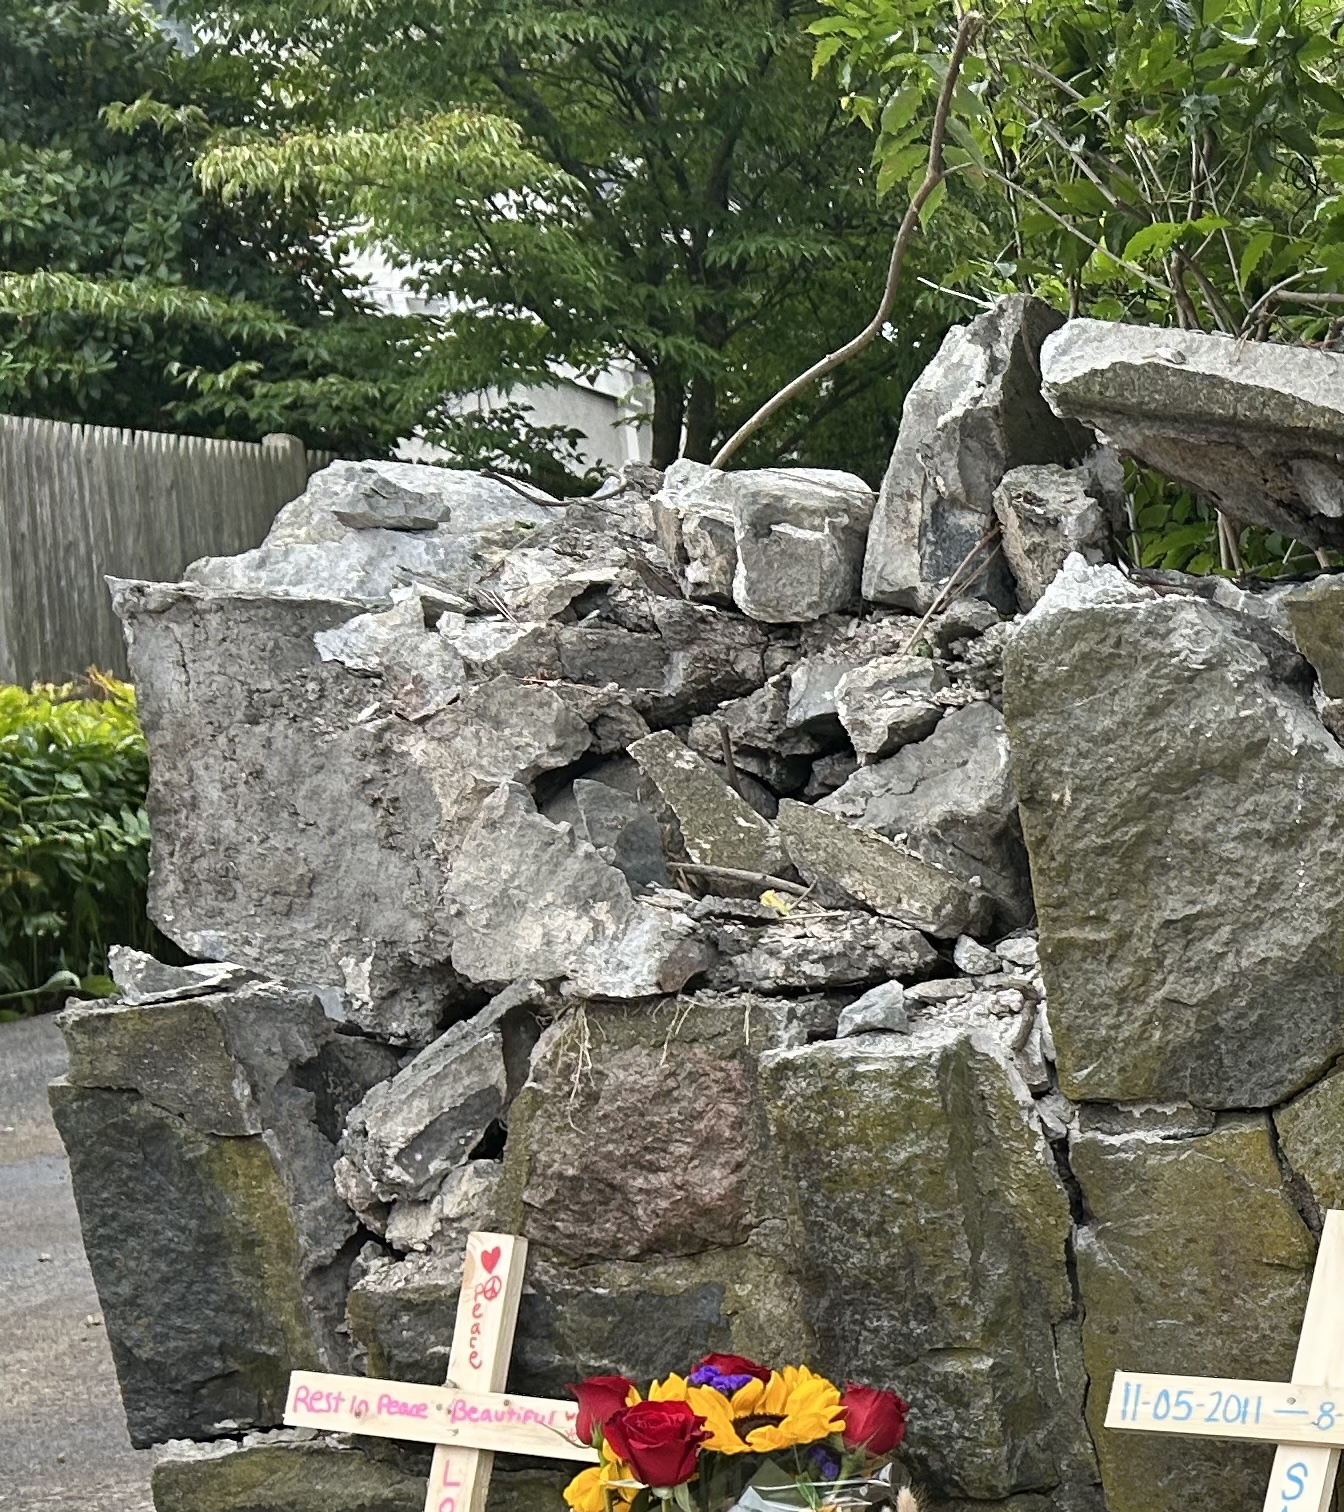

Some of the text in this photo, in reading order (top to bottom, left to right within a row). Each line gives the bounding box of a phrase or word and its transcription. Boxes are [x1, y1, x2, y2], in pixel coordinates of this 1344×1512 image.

[292, 1385, 346, 1414] Rest
[376, 1393, 429, 1420] Peace
[1120, 1381, 1263, 1425] 11-05-2011
